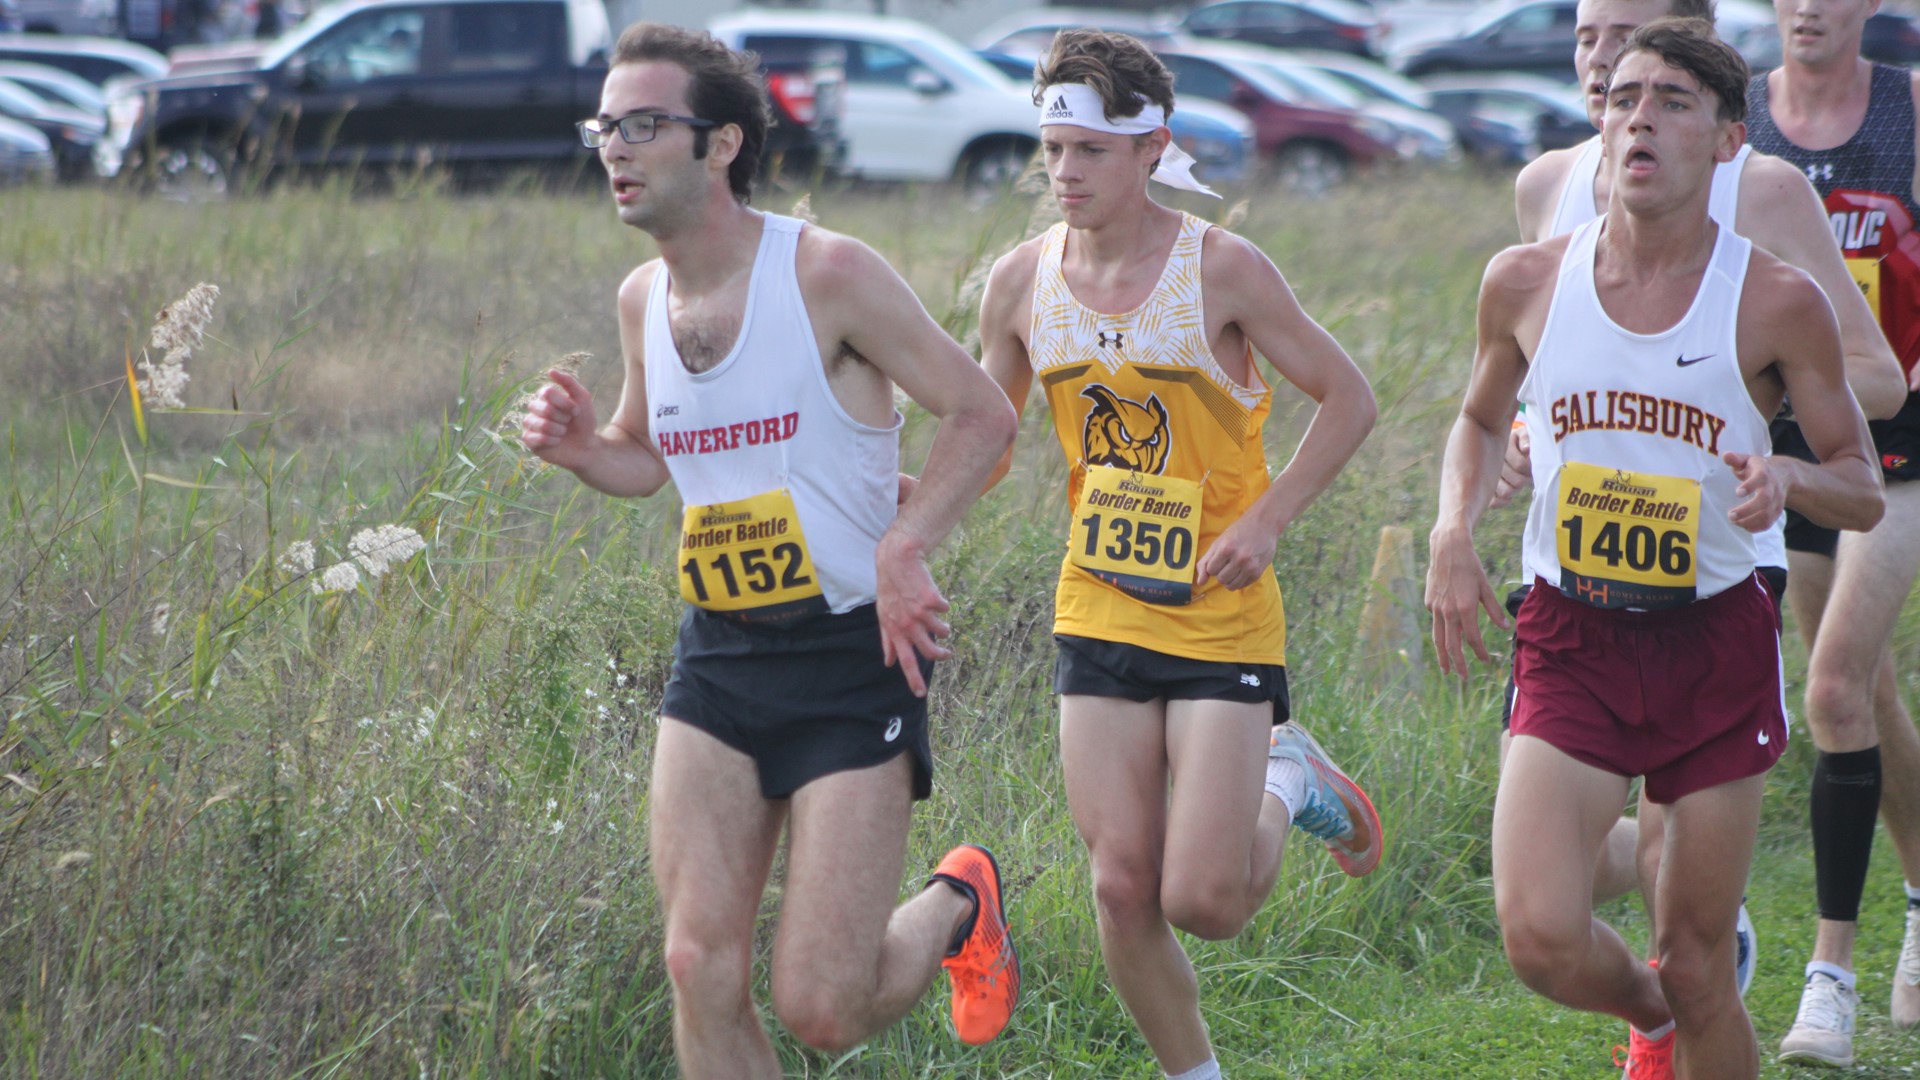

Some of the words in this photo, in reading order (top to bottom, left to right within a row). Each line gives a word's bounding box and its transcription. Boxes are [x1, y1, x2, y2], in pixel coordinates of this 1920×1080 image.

[1046, 110, 1074, 119] adidas
[658, 411, 799, 457] HAVERFORD
[1551, 390, 1726, 456] SALISBURY
[1087, 488, 1141, 514] Border
[1142, 497, 1192, 519] Battle
[1566, 487, 1630, 514] Border
[1631, 498, 1688, 522] Battle
[737, 517, 788, 541] Battle
[1082, 513, 1193, 570] 1350
[1562, 515, 1691, 576] 1406
[682, 541, 812, 602] 1152
